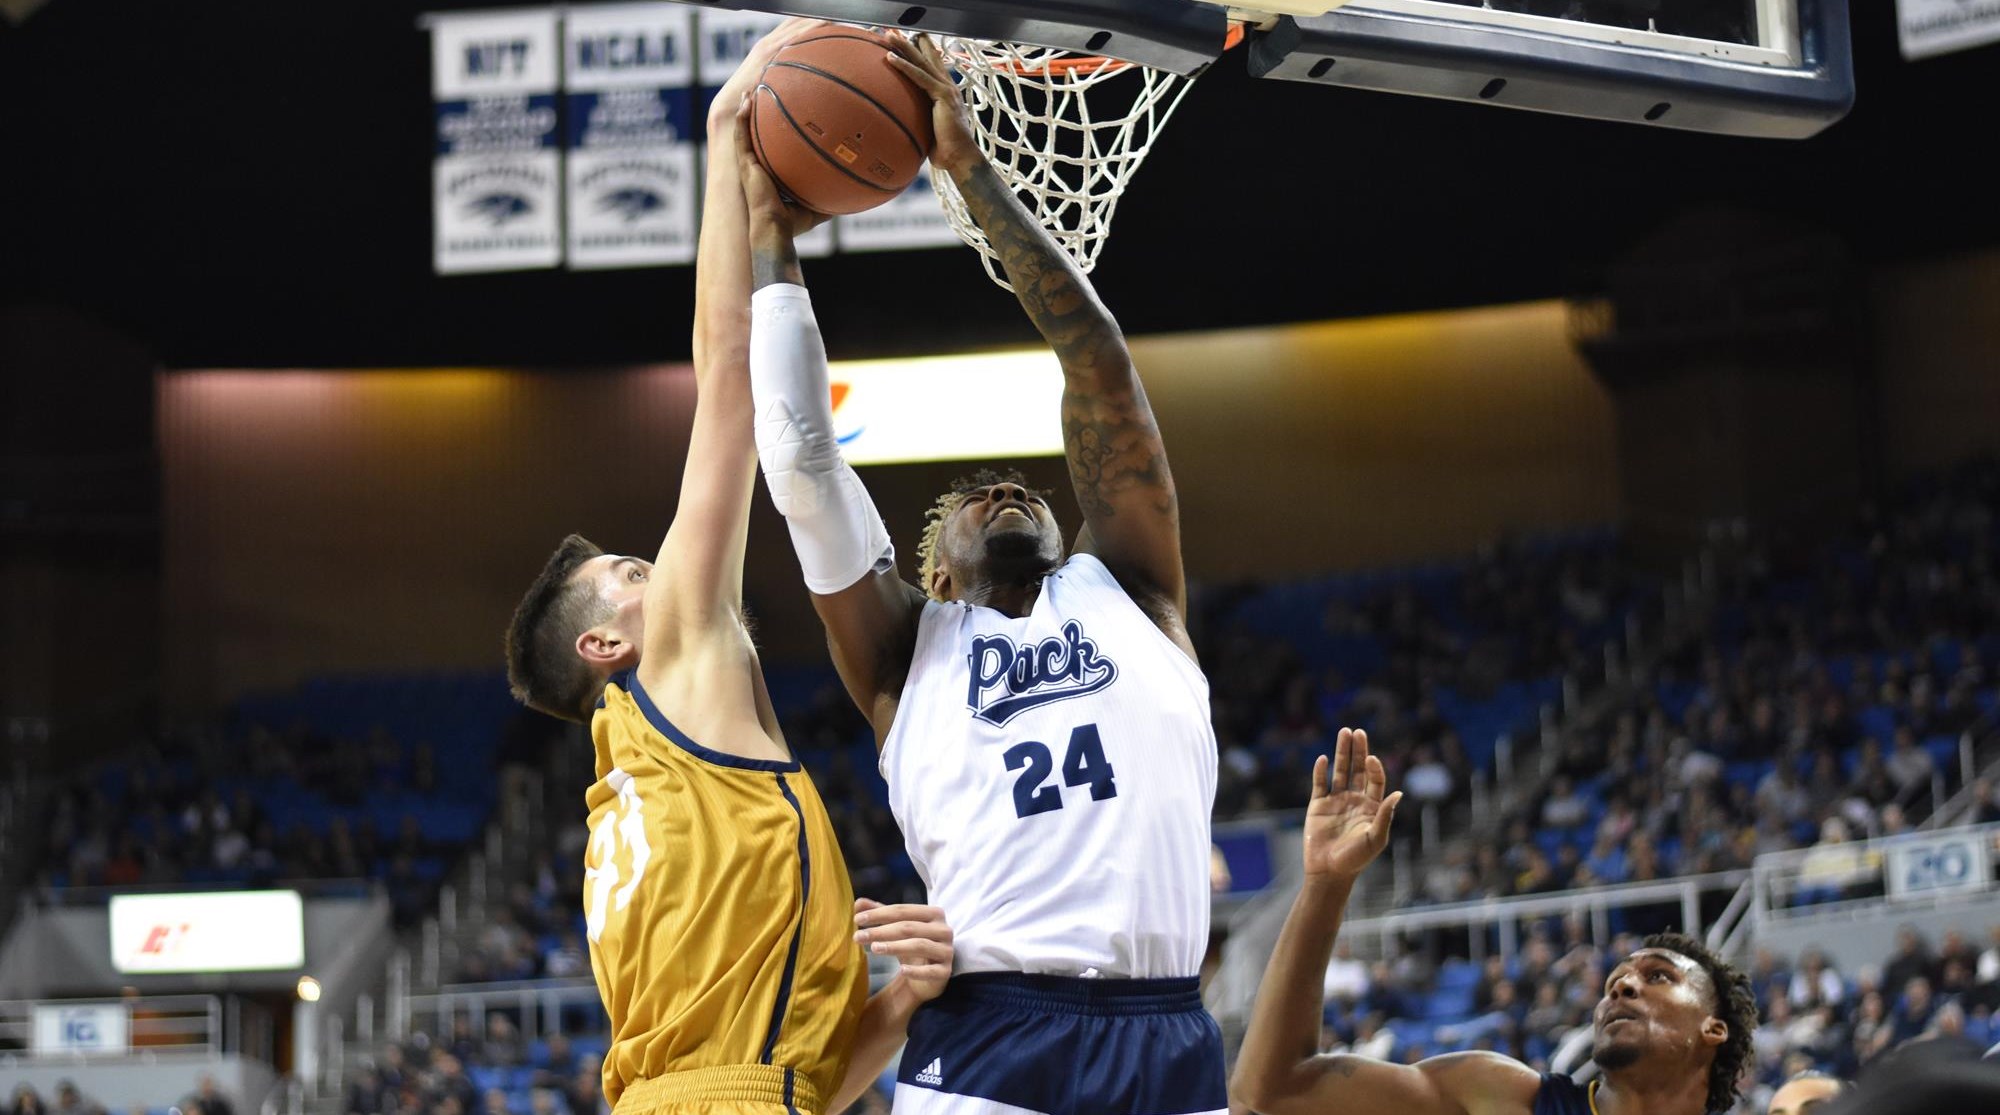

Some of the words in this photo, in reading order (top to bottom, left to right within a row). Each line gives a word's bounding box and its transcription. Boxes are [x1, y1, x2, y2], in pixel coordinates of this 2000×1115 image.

[578, 33, 676, 68] NCAA
[966, 619, 1119, 720] Pack
[1003, 723, 1118, 819] 24
[915, 1072, 943, 1085] adidas
